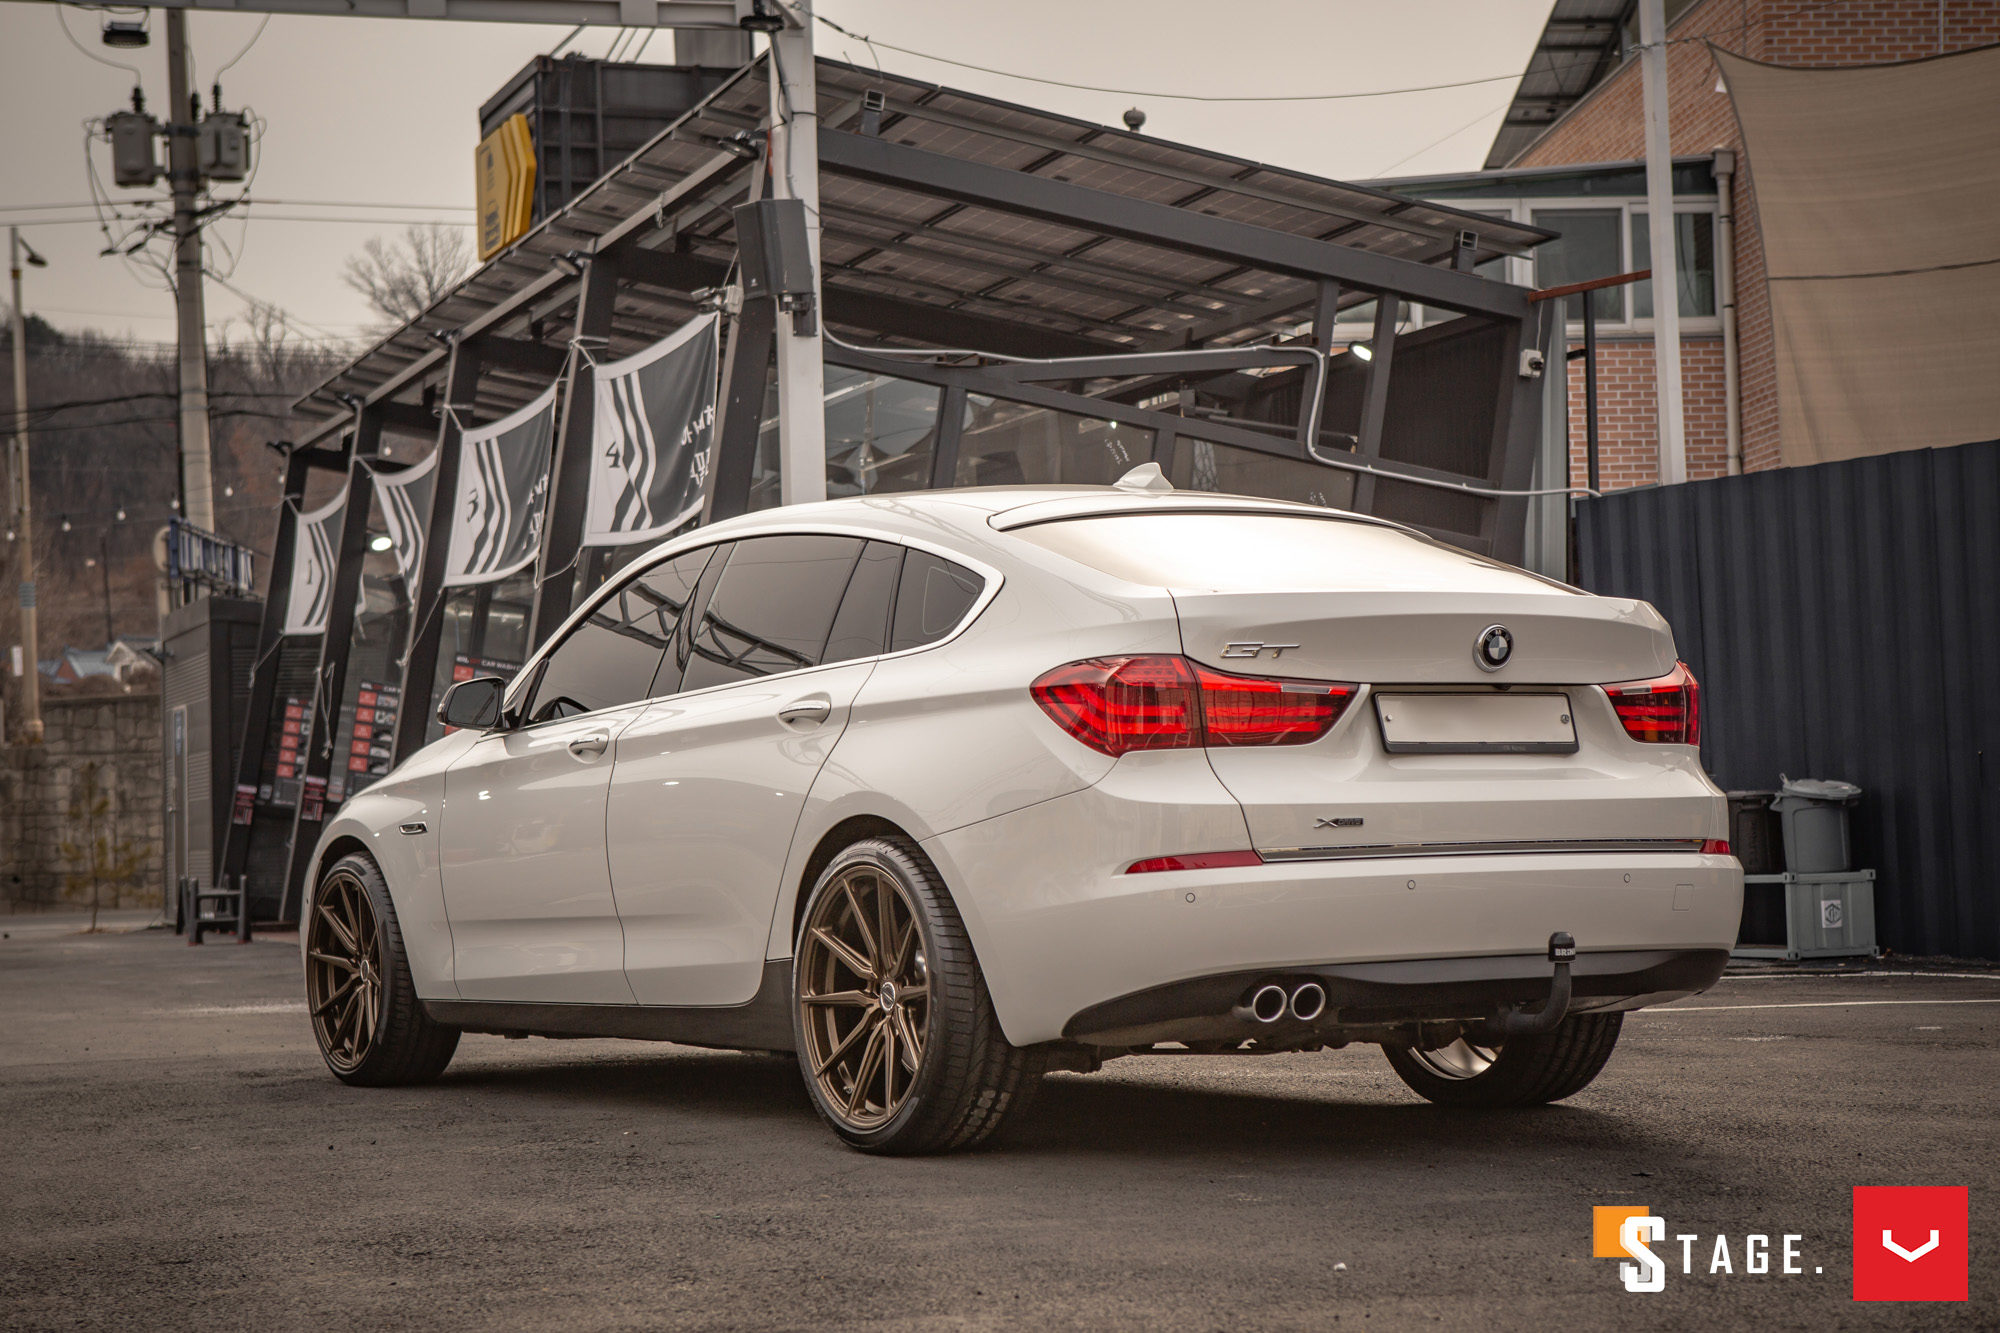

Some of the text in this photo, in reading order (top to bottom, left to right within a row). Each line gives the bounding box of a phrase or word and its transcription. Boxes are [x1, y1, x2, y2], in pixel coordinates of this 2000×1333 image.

[605, 441, 620, 468] 4
[1221, 641, 1301, 658] GT
[481, 659, 496, 667] CAR
